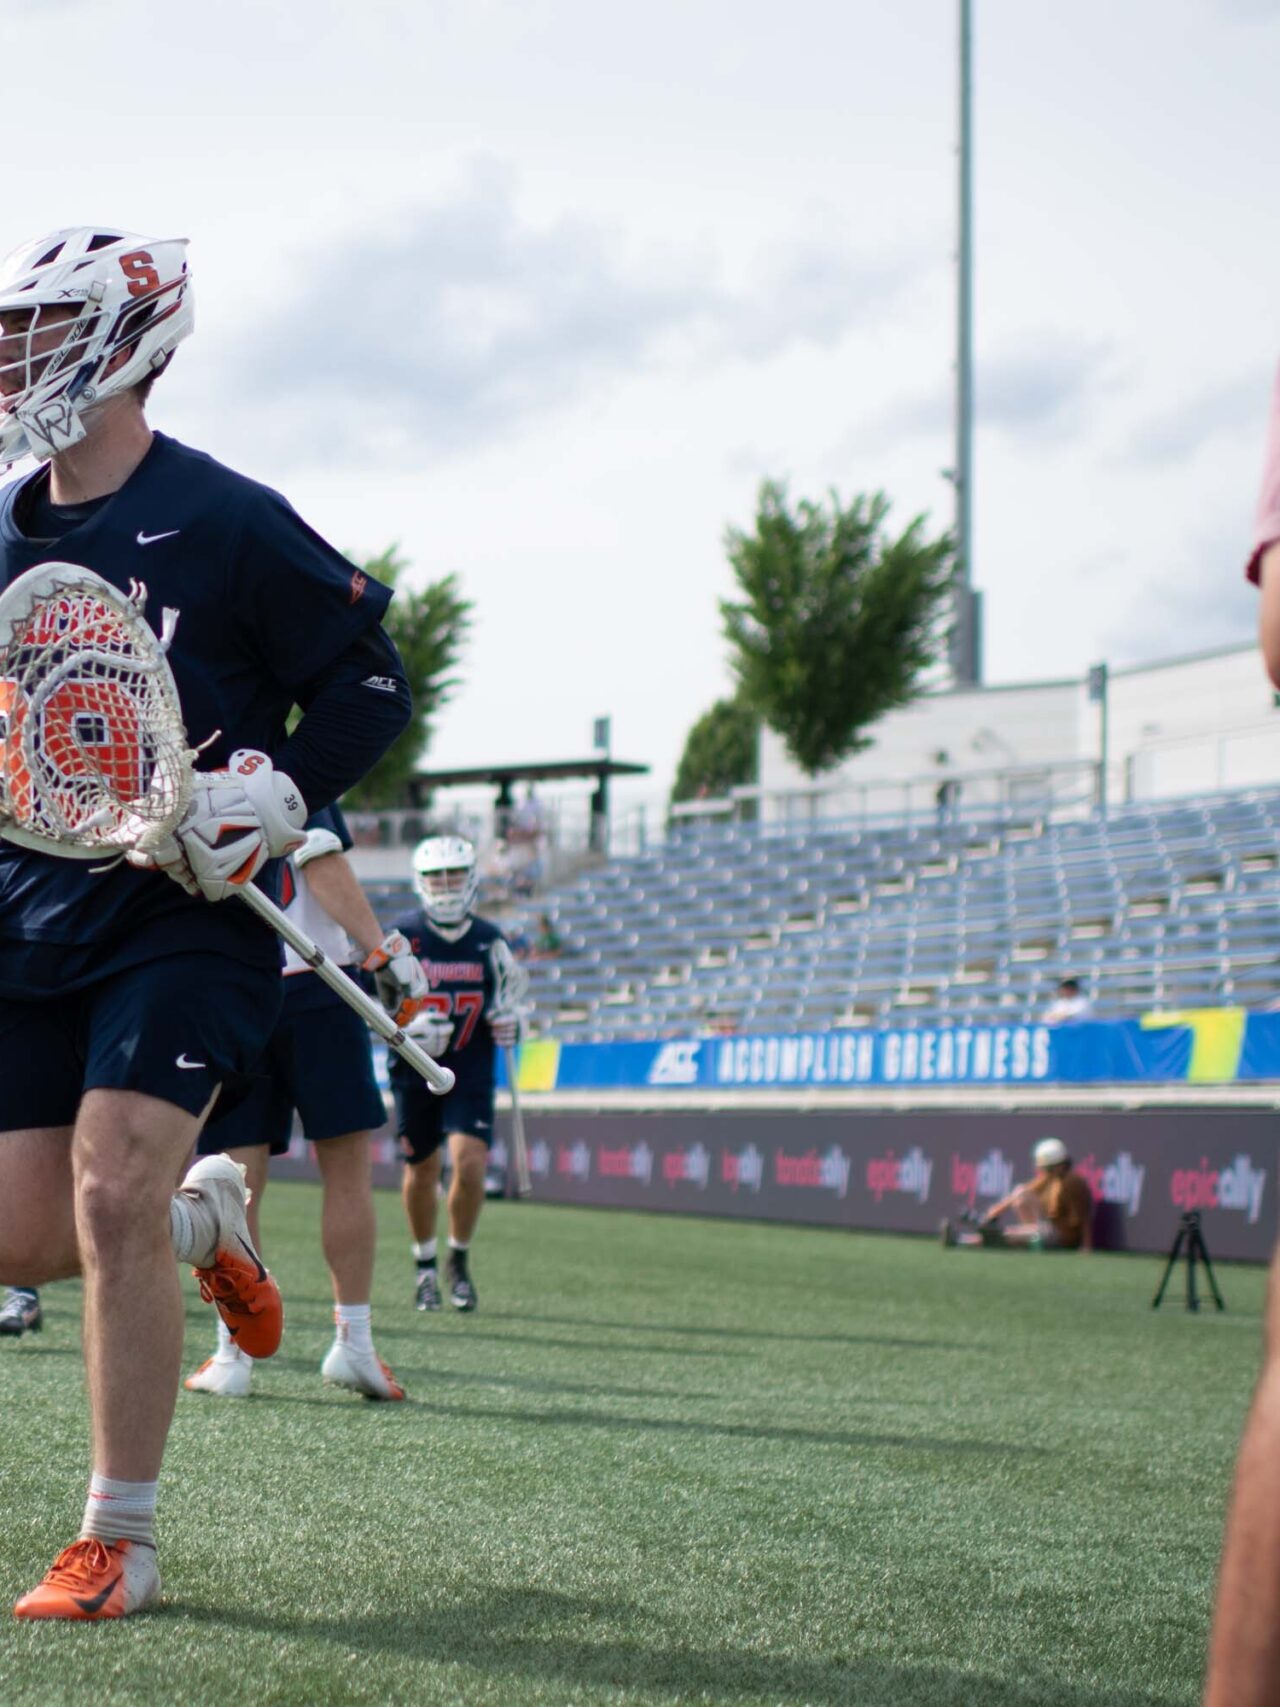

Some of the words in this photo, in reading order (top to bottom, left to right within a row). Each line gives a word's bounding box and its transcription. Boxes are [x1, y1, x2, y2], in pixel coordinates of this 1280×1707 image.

[118, 250, 160, 298] S
[361, 675, 397, 692] ACC
[237, 755, 266, 776] S
[283, 794, 299, 812] 39
[719, 1034, 874, 1084] ACCOMPLISH
[883, 1027, 1051, 1081] GREATNESS
[1171, 1154, 1267, 1224] epically
